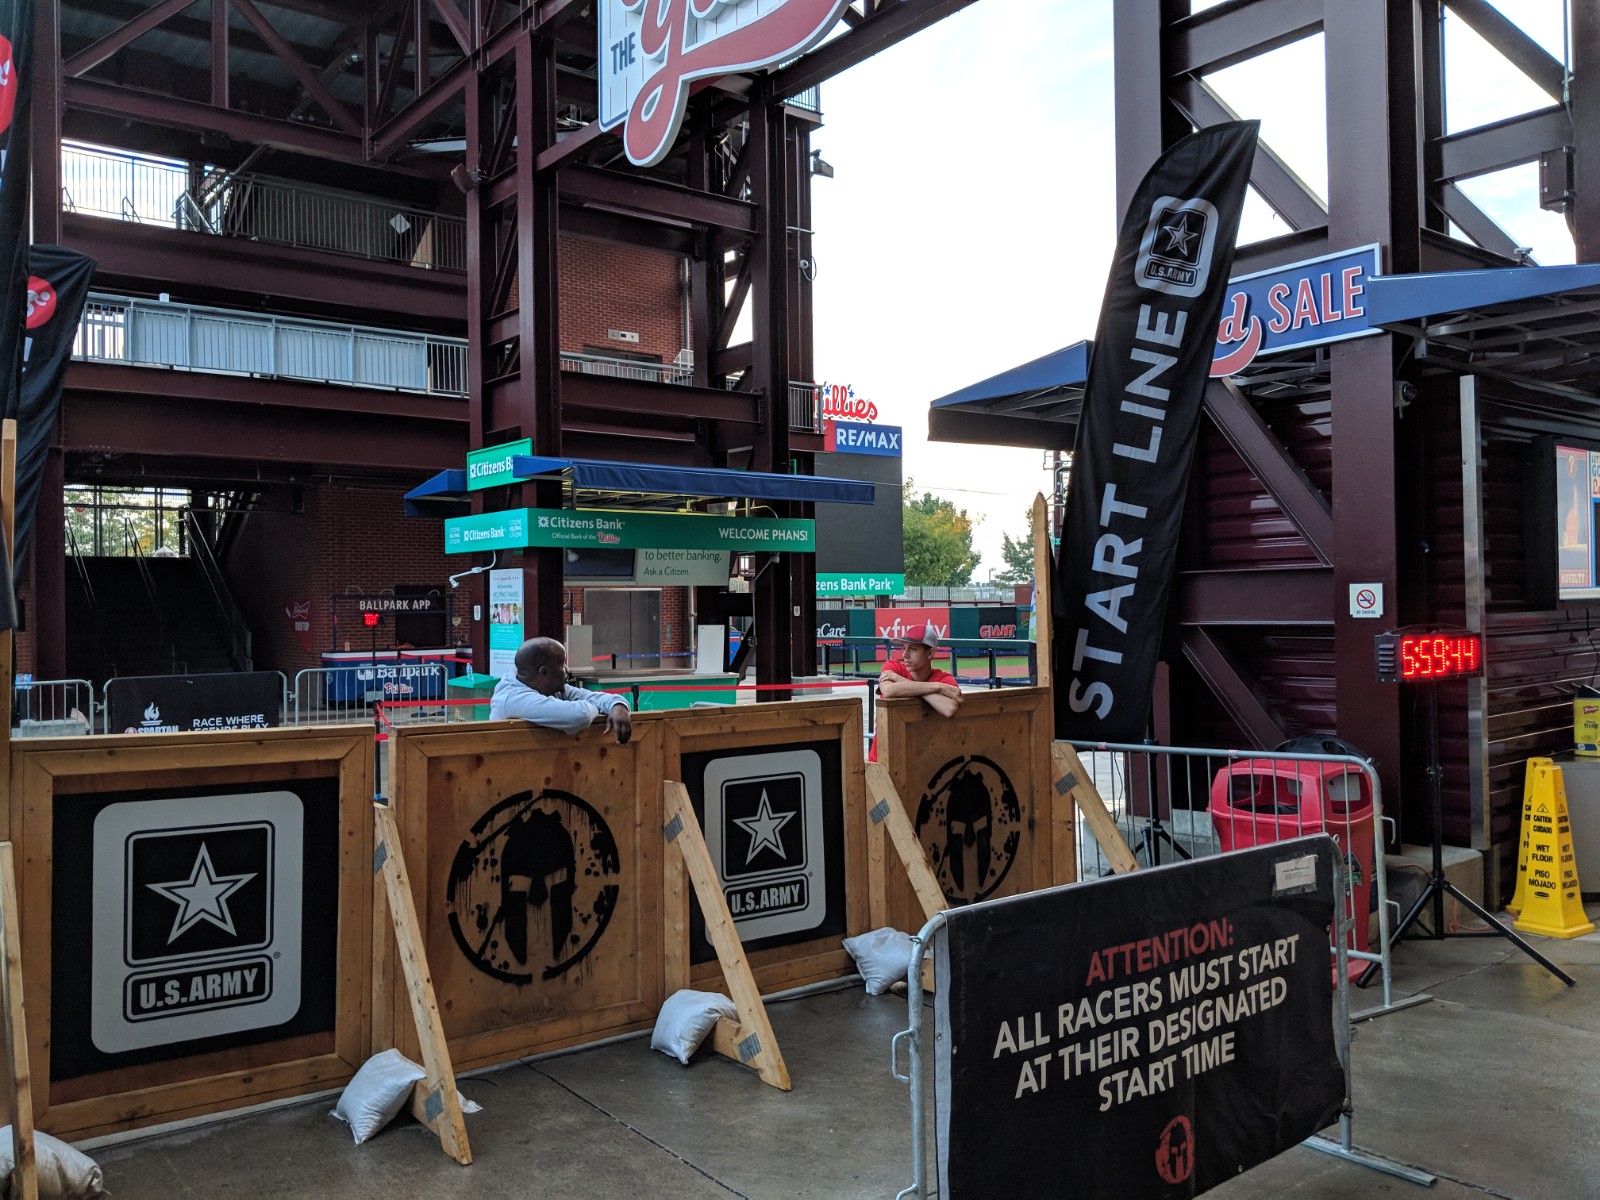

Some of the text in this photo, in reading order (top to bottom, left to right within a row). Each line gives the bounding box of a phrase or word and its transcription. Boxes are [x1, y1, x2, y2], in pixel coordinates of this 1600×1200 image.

[610, 31, 636, 75] THE
[1268, 265, 1365, 334] SALE
[822, 384, 879, 421] illies
[836, 428, 899, 450] RE/MAX
[476, 461, 505, 477] Citizens
[1068, 303, 1189, 721] START LINE
[550, 516, 622, 530] Citizens Bank
[470, 529, 490, 541] Citizens
[490, 526, 505, 538] Bank
[718, 527, 808, 541] WELCOME PHANS!
[645, 550, 722, 563] to better banking.
[644, 567, 657, 576] Ask
[664, 566, 691, 576] Citizen.
[815, 577, 892, 591] zens Bank Park
[359, 599, 431, 611] BALLPARK APP
[816, 623, 847, 638] aCare
[979, 624, 1017, 638] GIANT
[376, 662, 440, 680] Balpark
[192, 714, 264, 727] RACE WHERE
[137, 725, 179, 734] SPARTAN
[1533, 814, 1552, 824] CAUTION
[1536, 844, 1550, 853] WET
[1531, 853, 1553, 864] FLOOR
[1535, 869, 1550, 879] PISO
[1528, 878, 1556, 890] MOJADO
[1085, 917, 1234, 987] ATTENTION:
[993, 934, 1299, 1058] ALL RACERS MUST START
[1014, 976, 1287, 1099] AT THEIR DESIGNATED
[1099, 1031, 1235, 1112] START TIME
